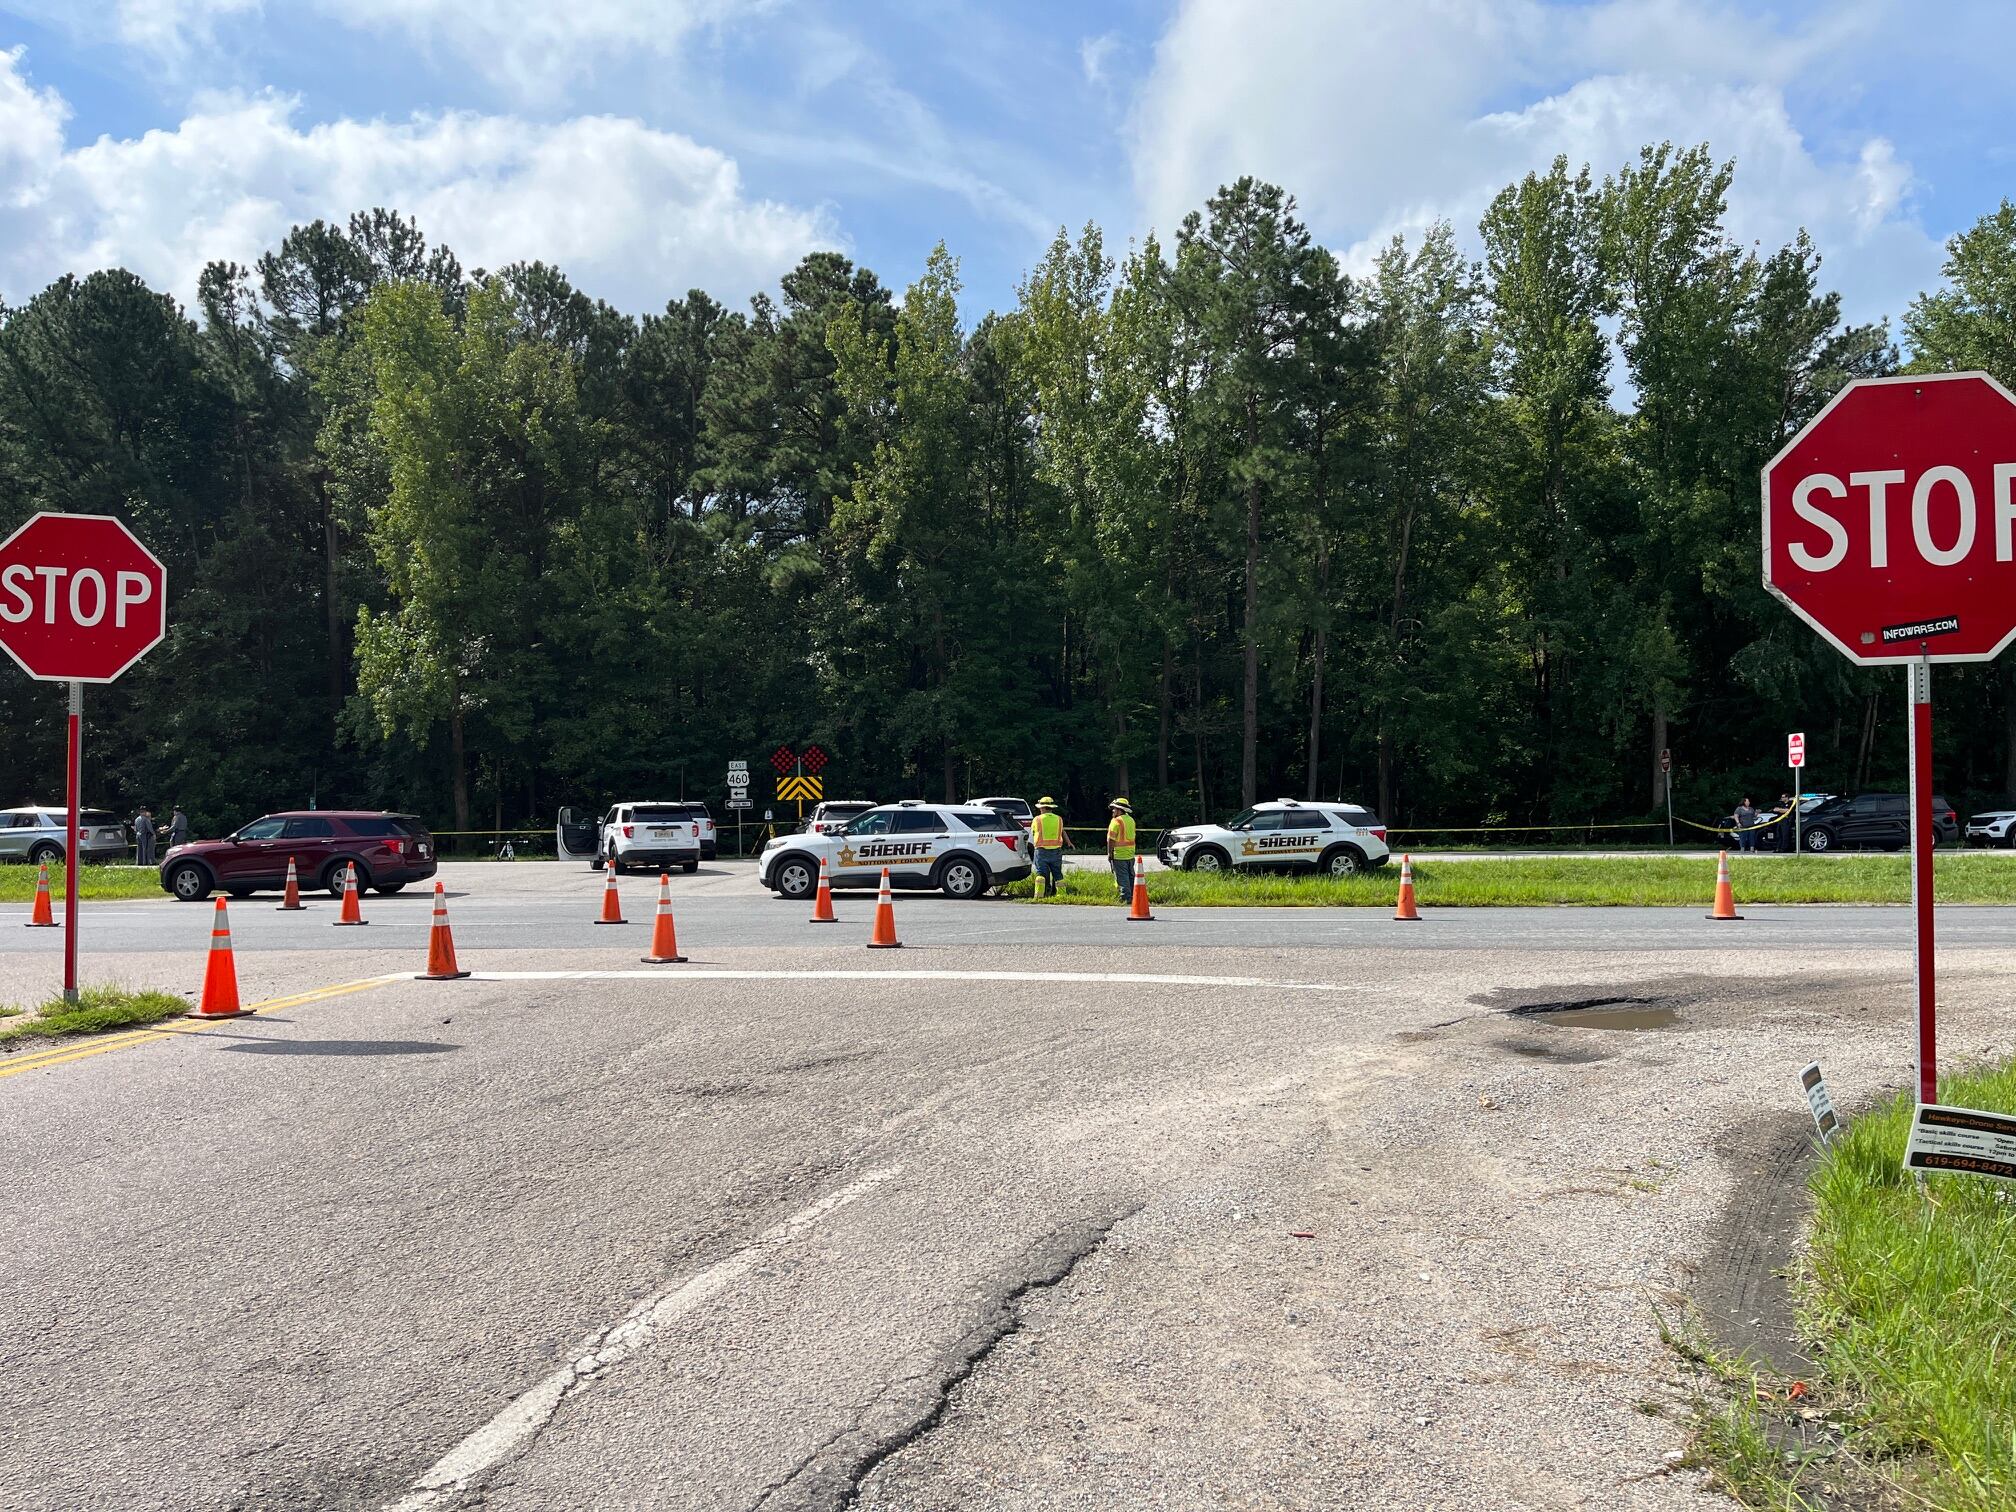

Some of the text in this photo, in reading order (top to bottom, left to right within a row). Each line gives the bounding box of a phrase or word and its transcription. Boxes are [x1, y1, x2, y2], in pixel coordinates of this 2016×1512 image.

[0, 564, 152, 628] STOP
[1883, 619, 1958, 639] INFOWARS.COM
[729, 774, 748, 784] 460
[859, 842, 932, 858] SHERIFF
[1259, 836, 1319, 848] SHERIFF
[1989, 1148, 2007, 1157] 12pm
[1925, 1156, 2014, 1174] 619-694-8472
